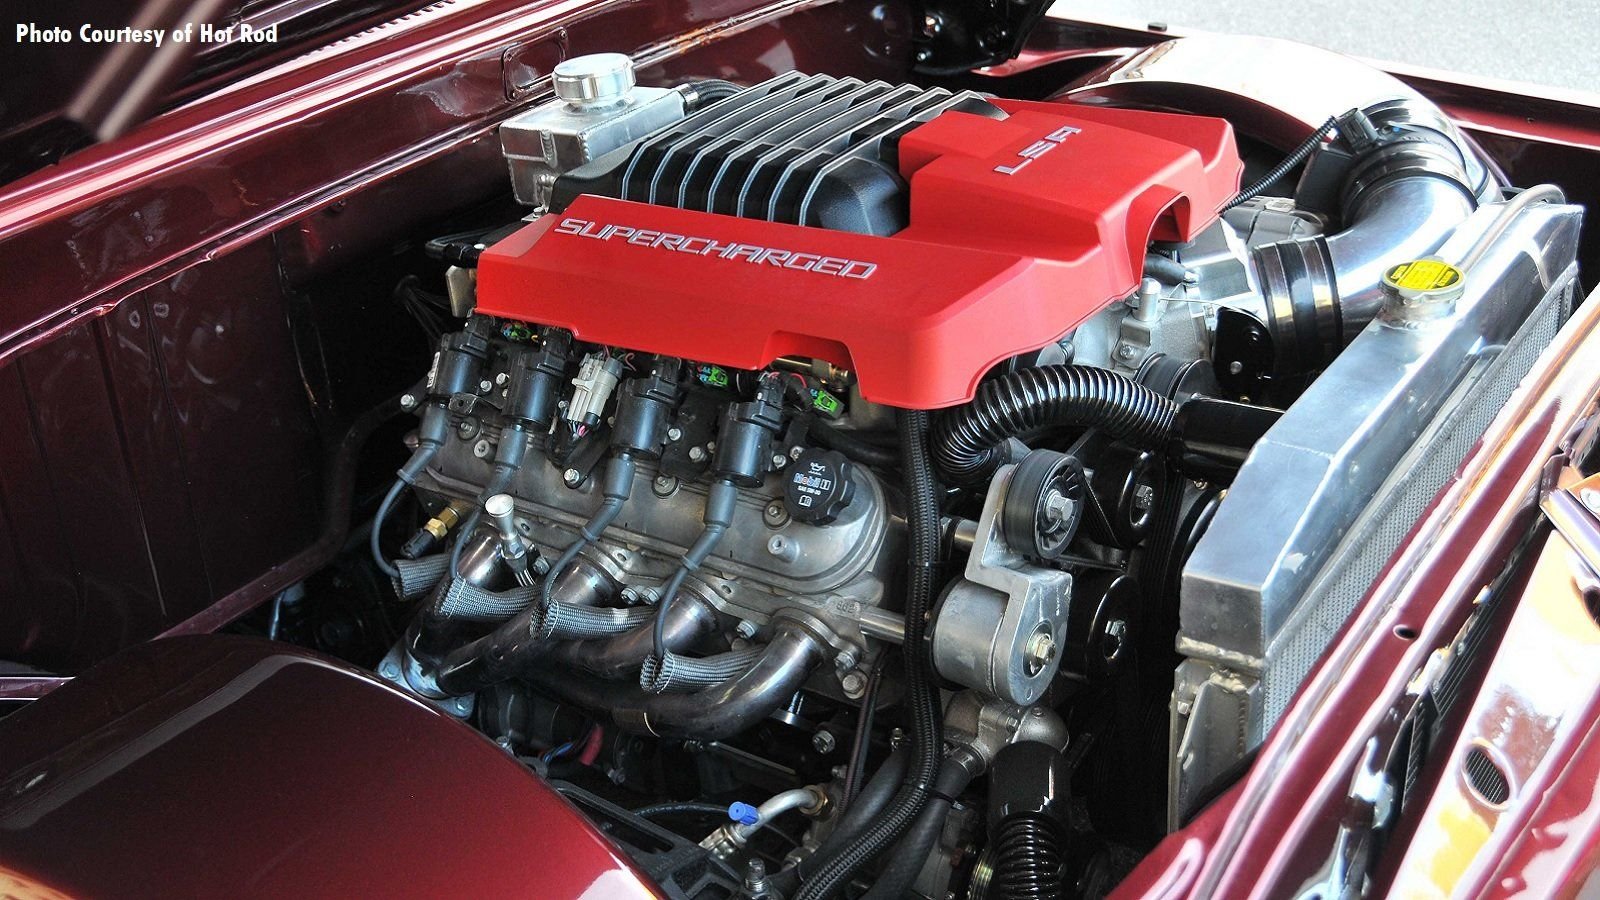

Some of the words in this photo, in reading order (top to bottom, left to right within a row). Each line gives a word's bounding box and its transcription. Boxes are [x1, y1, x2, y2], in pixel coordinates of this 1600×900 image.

[993, 125, 1082, 175] LSA
[554, 218, 878, 280] SUPERCHARGED
[793, 473, 821, 488] Mobil
